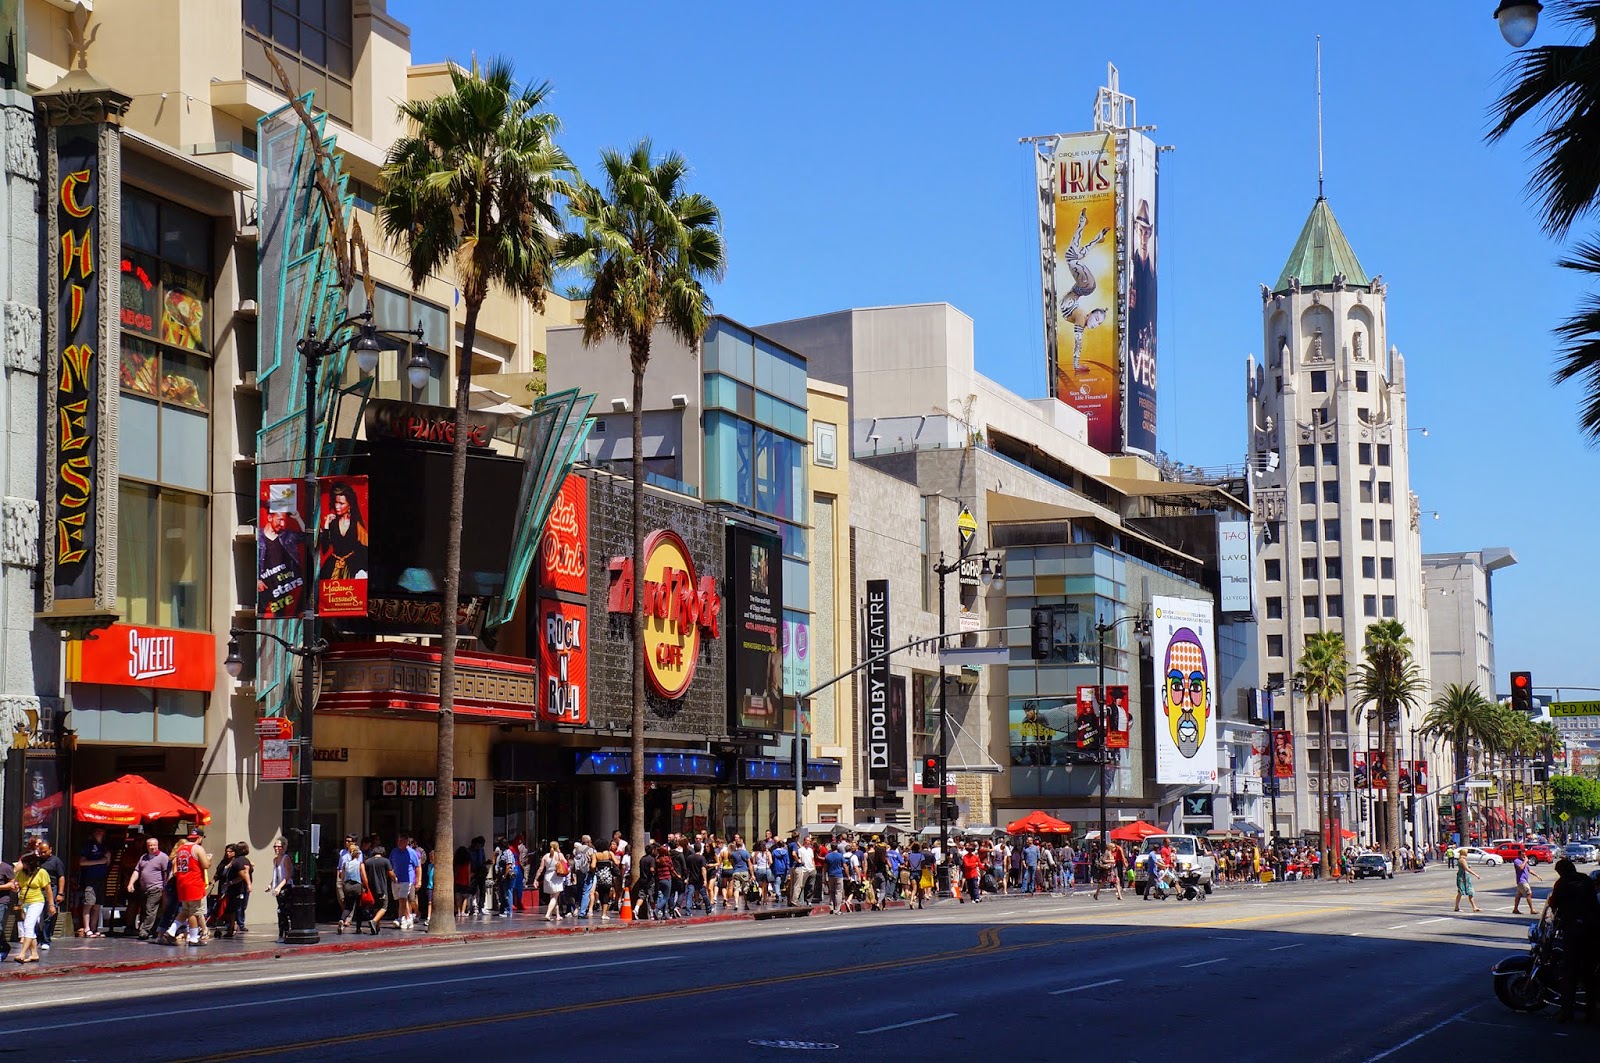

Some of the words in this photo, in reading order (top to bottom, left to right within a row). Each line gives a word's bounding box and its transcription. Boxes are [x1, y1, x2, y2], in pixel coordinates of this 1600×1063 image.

[1060, 159, 1110, 194] IRIS
[58, 168, 96, 565] CHINESE
[1129, 349, 1156, 391] VEG
[1222, 531, 1247, 540] TAO
[543, 530, 585, 577] Drink
[260, 563, 287, 580] where
[272, 577, 304, 598] stars
[323, 580, 355, 593] Madame
[323, 591, 360, 607] Tussauds
[269, 594, 295, 613] are
[546, 612, 581, 652] ROCK
[870, 591, 885, 674] THEATRE
[655, 642, 684, 666] CAFE
[547, 675, 580, 720] ROLL
[871, 679, 886, 740] DOLBY
[1554, 704, 1577, 714] PED
[1581, 702, 1600, 713] XIN
